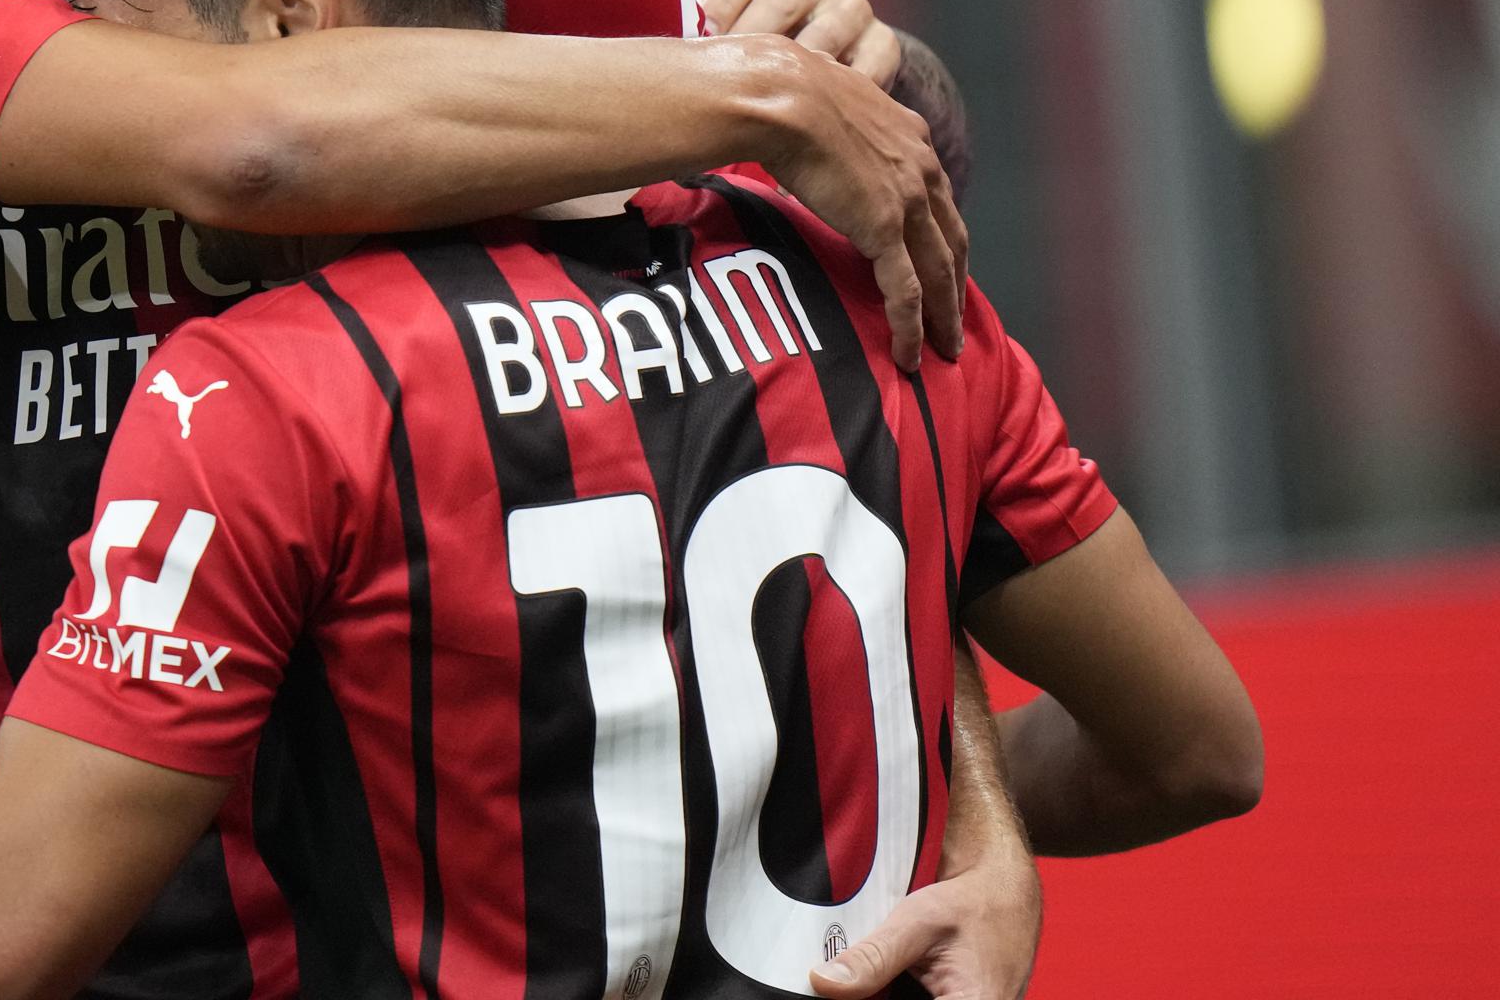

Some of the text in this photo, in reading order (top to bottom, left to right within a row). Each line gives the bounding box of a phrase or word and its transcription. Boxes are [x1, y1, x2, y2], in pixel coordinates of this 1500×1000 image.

[13, 333, 170, 445] BETT
[47, 618, 232, 692] BitMEX
[507, 463, 921, 1000] 10
